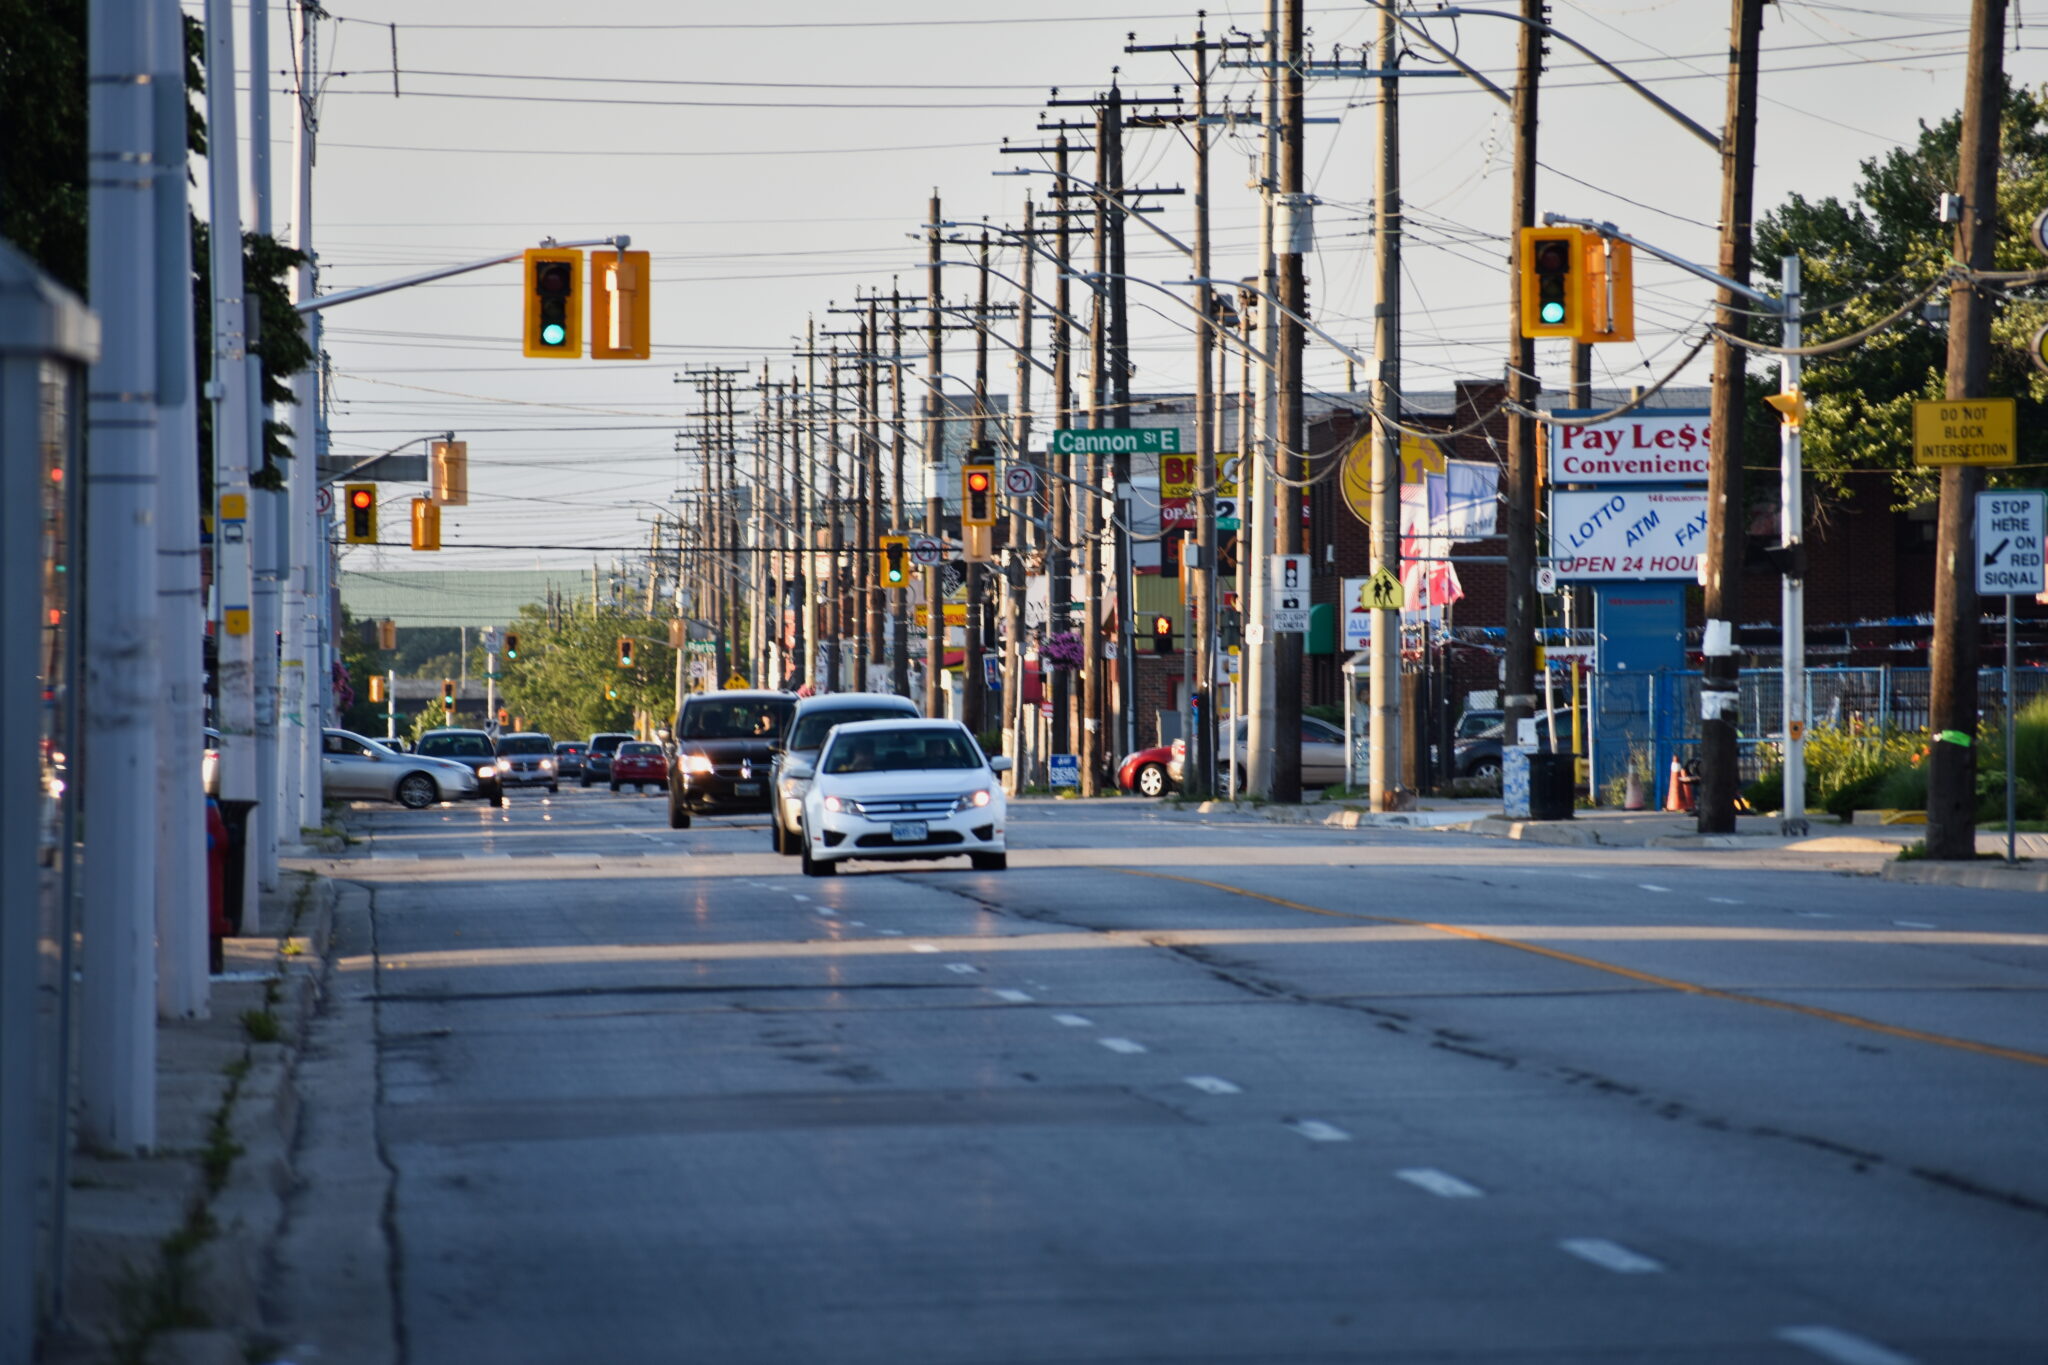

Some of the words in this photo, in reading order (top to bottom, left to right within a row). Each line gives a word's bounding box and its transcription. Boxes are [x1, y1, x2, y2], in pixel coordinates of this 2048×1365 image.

[1941, 408, 1957, 421] DO
[1964, 407, 1987, 420] NOT
[1944, 426, 1984, 438] BLOCK
[1059, 432, 1137, 452] Cannon
[1143, 431, 1157, 445] St
[1160, 430, 1174, 450] E
[1561, 424, 1625, 456] Pay
[1922, 444, 2008, 457] INTERSECTION
[1563, 454, 1710, 474] Convenienc
[1992, 501, 2030, 514] STOP
[1569, 495, 1626, 548] LOTTO
[1675, 510, 1708, 547] FAX
[1992, 518, 2029, 531] HERE
[1625, 510, 1660, 548] ATM
[2015, 537, 2036, 549] ON
[1559, 556, 1616, 573] OPEN
[1622, 556, 1643, 572] 24
[1650, 555, 1698, 572] HOU
[2011, 554, 2040, 566] RED
[1985, 572, 2037, 585] SIGNAL
